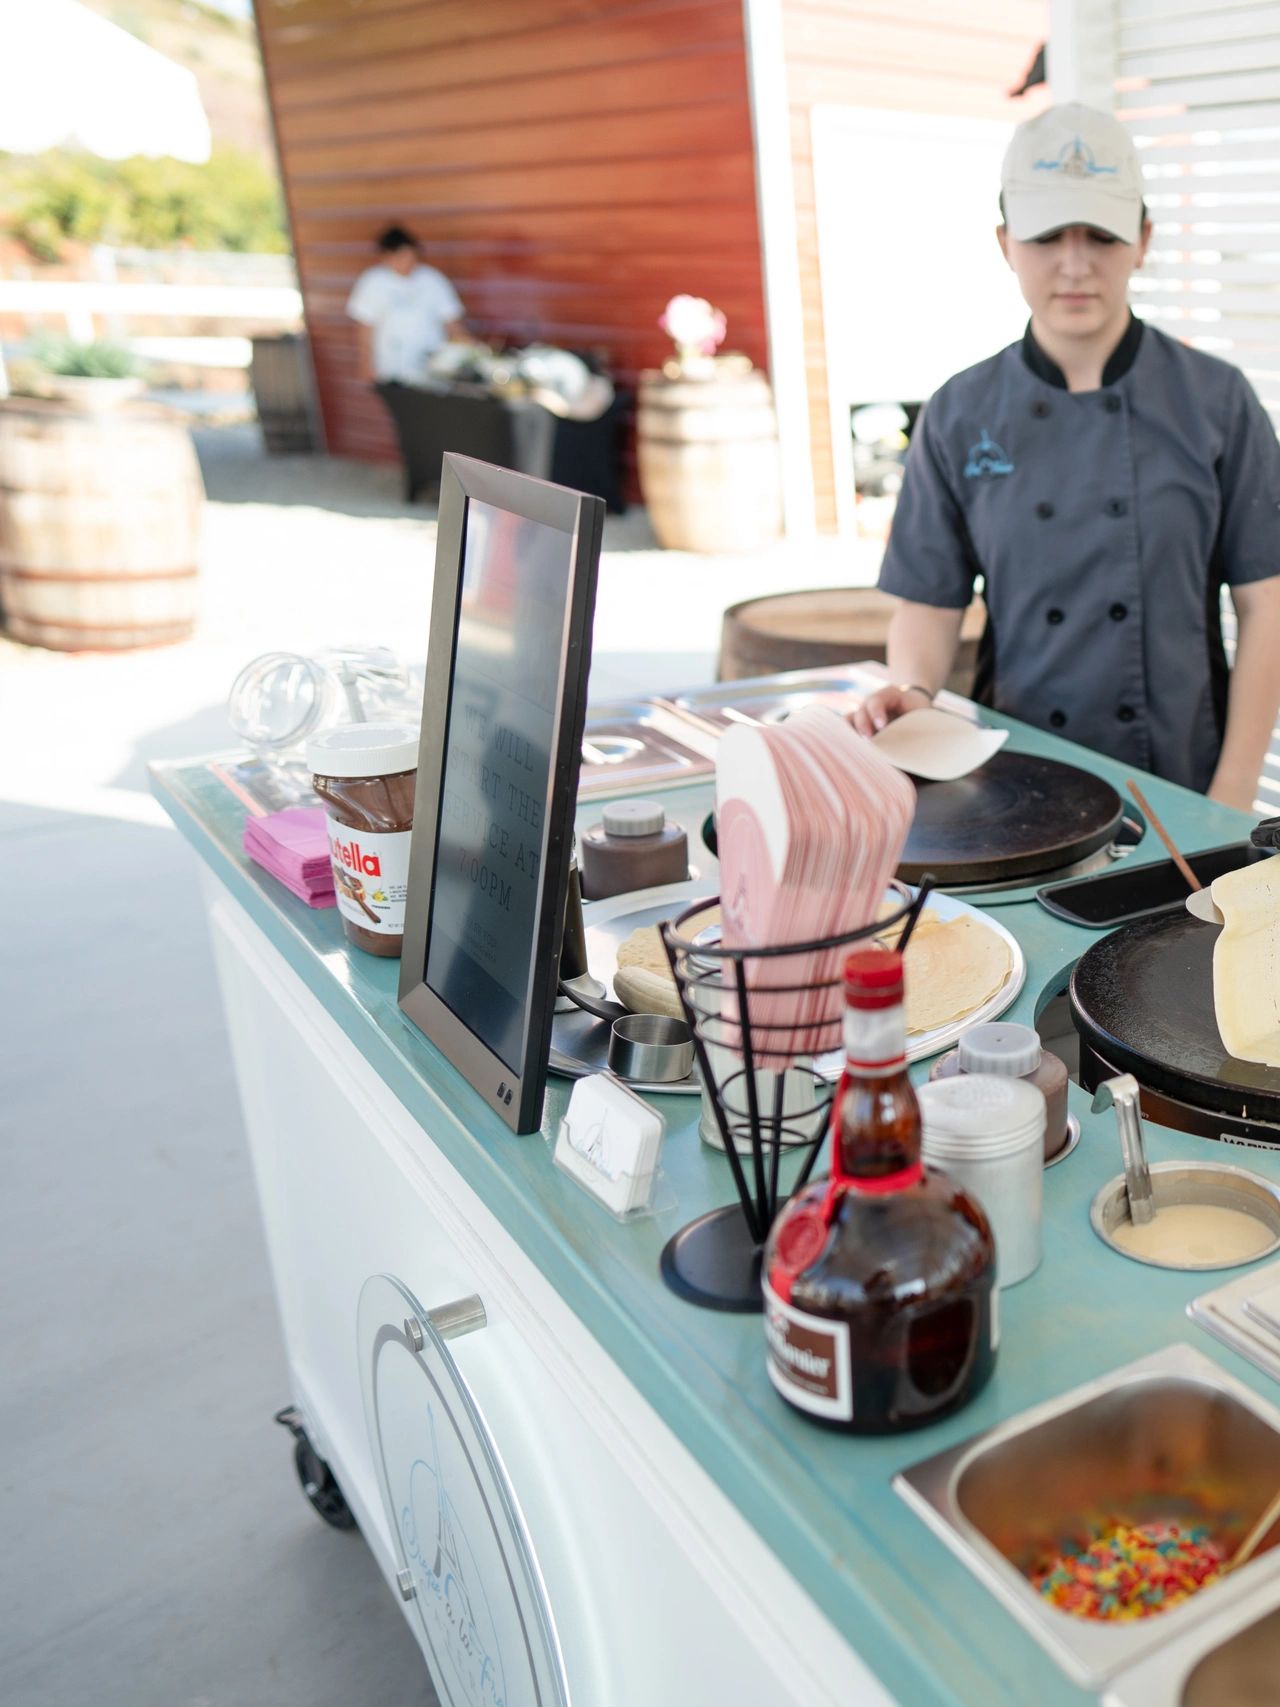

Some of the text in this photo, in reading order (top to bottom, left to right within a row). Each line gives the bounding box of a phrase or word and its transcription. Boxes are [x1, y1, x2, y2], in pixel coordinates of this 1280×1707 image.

[464, 703, 534, 772] WE WILL
[450, 745, 541, 829] START THE
[444, 788, 540, 880] SERVICE AT
